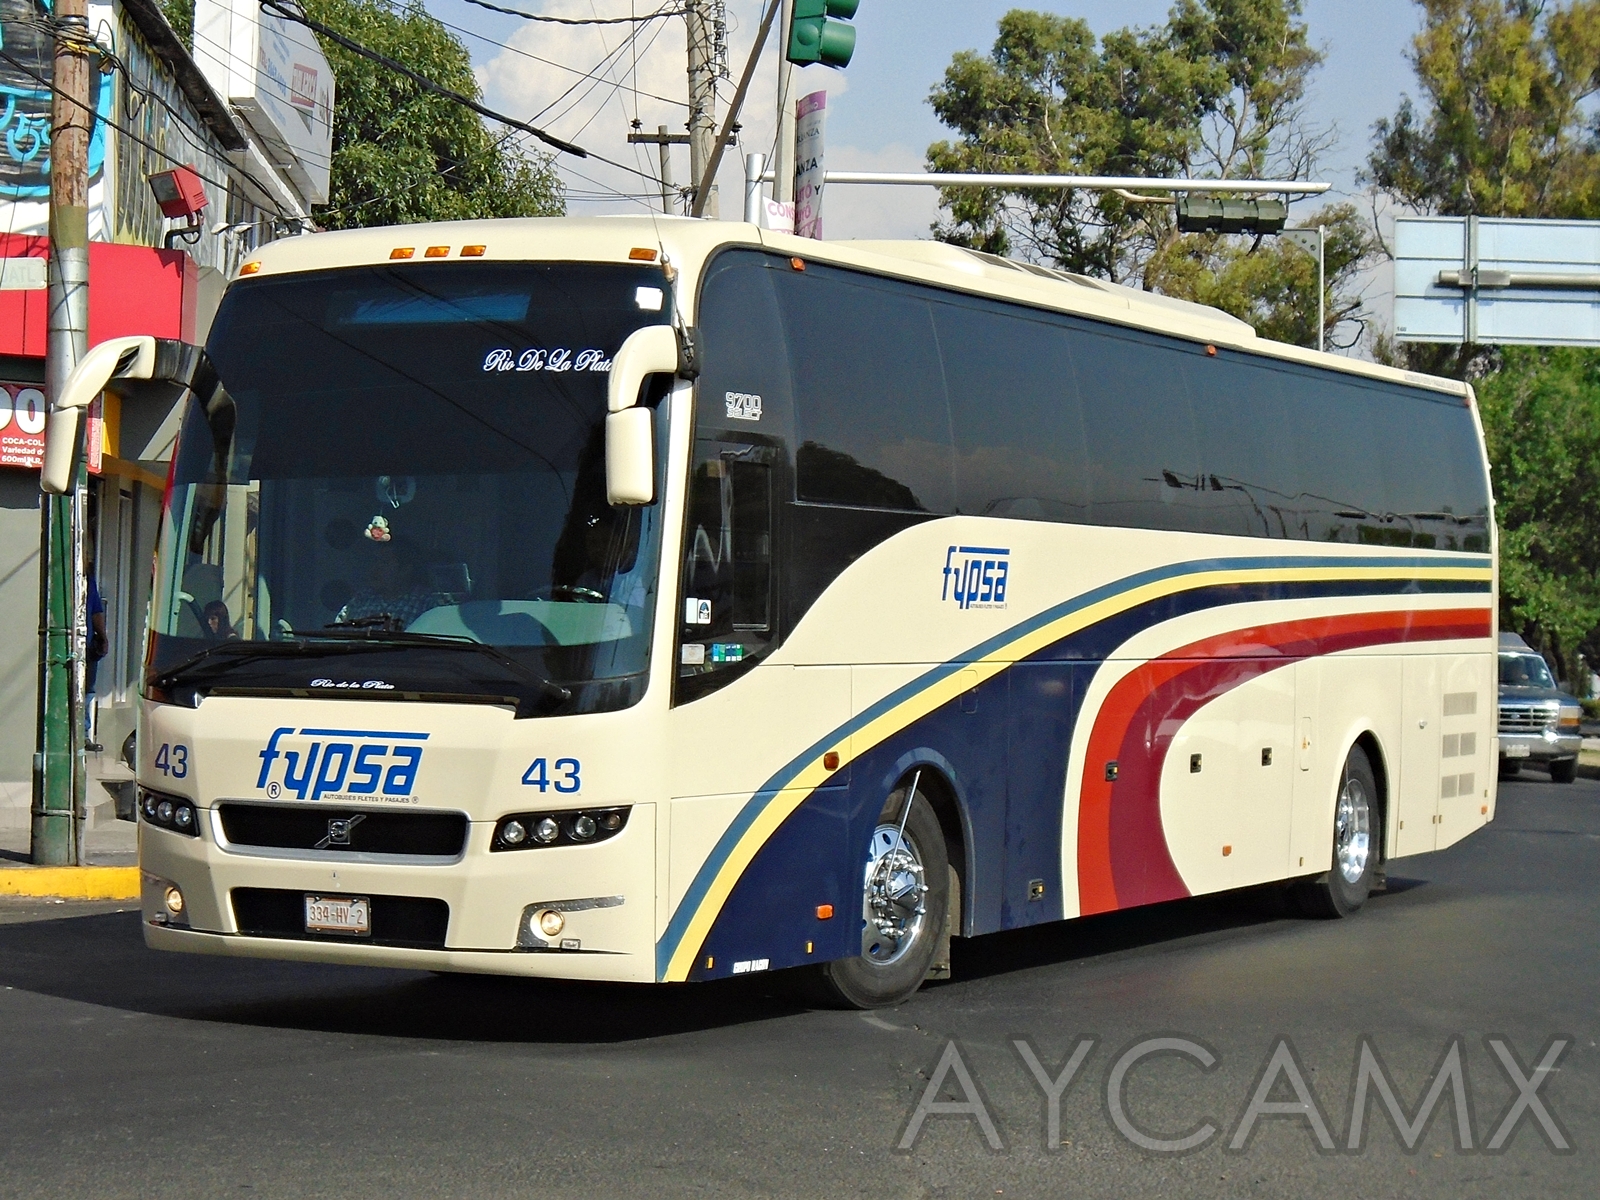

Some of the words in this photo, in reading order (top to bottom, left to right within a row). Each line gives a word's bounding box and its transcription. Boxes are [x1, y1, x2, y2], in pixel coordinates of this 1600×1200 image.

[815, 185, 821, 196] Y
[483, 349, 515, 371] Rio
[516, 349, 547, 371] De
[545, 348, 571, 372] La
[726, 391, 761, 410] 9700
[2, 437, 44, 446] COCA-COL
[2, 446, 36, 455] Variedad
[942, 546, 1010, 609] fypsa
[155, 743, 188, 778] 43
[256, 727, 430, 801] fypsa
[521, 757, 581, 793] 43
[309, 905, 364, 925] 334-HV-2
